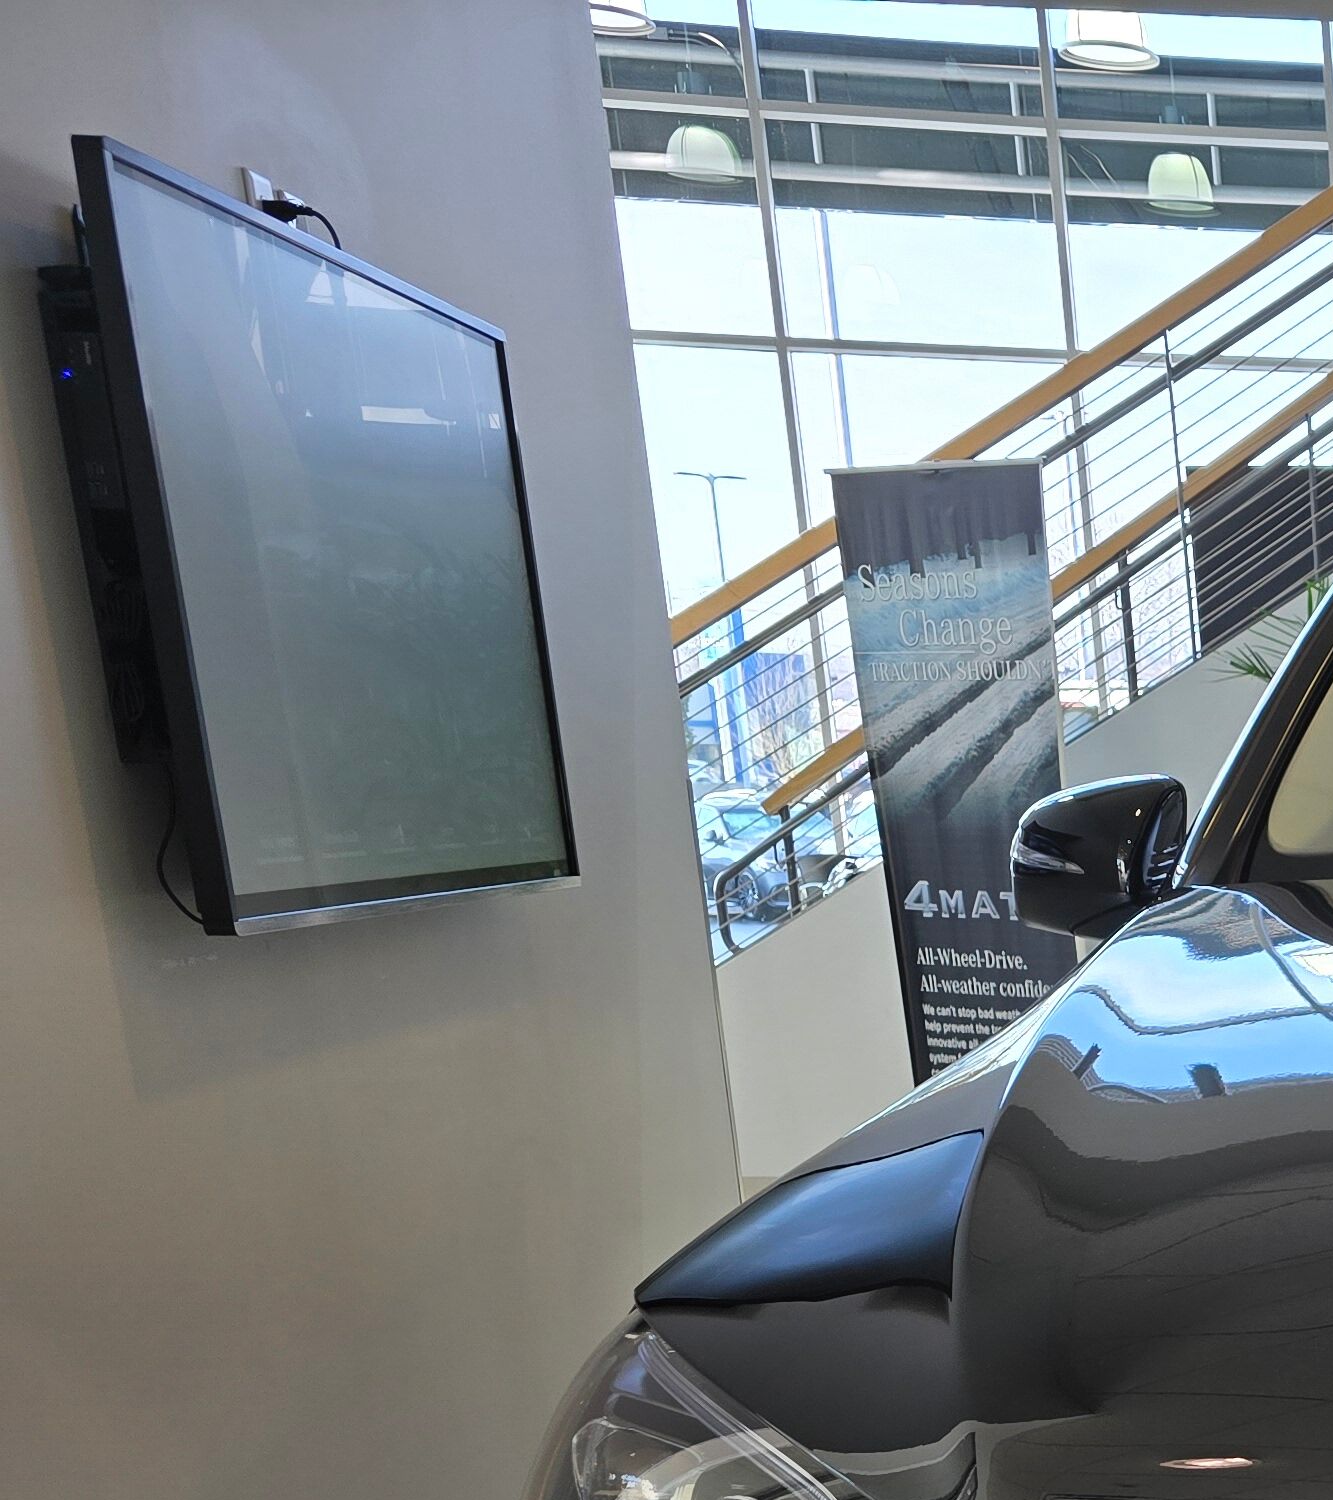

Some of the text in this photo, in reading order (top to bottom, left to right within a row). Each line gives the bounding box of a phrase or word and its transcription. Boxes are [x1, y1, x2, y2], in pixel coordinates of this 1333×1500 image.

[857, 564, 978, 602] Seasons
[900, 609, 1014, 655] Change
[871, 661, 951, 682] TRACTION
[916, 946, 1028, 970] All-Wheel-Drive.
[920, 974, 1053, 998] All-weather confide
[922, 1003, 935, 1016] We
[936, 1005, 957, 1018] can't
[957, 1006, 977, 1020] stop
[977, 1007, 995, 1019] bad
[924, 1019, 941, 1034] help
[942, 1023, 975, 1034] prevent
[975, 1022, 990, 1035] the
